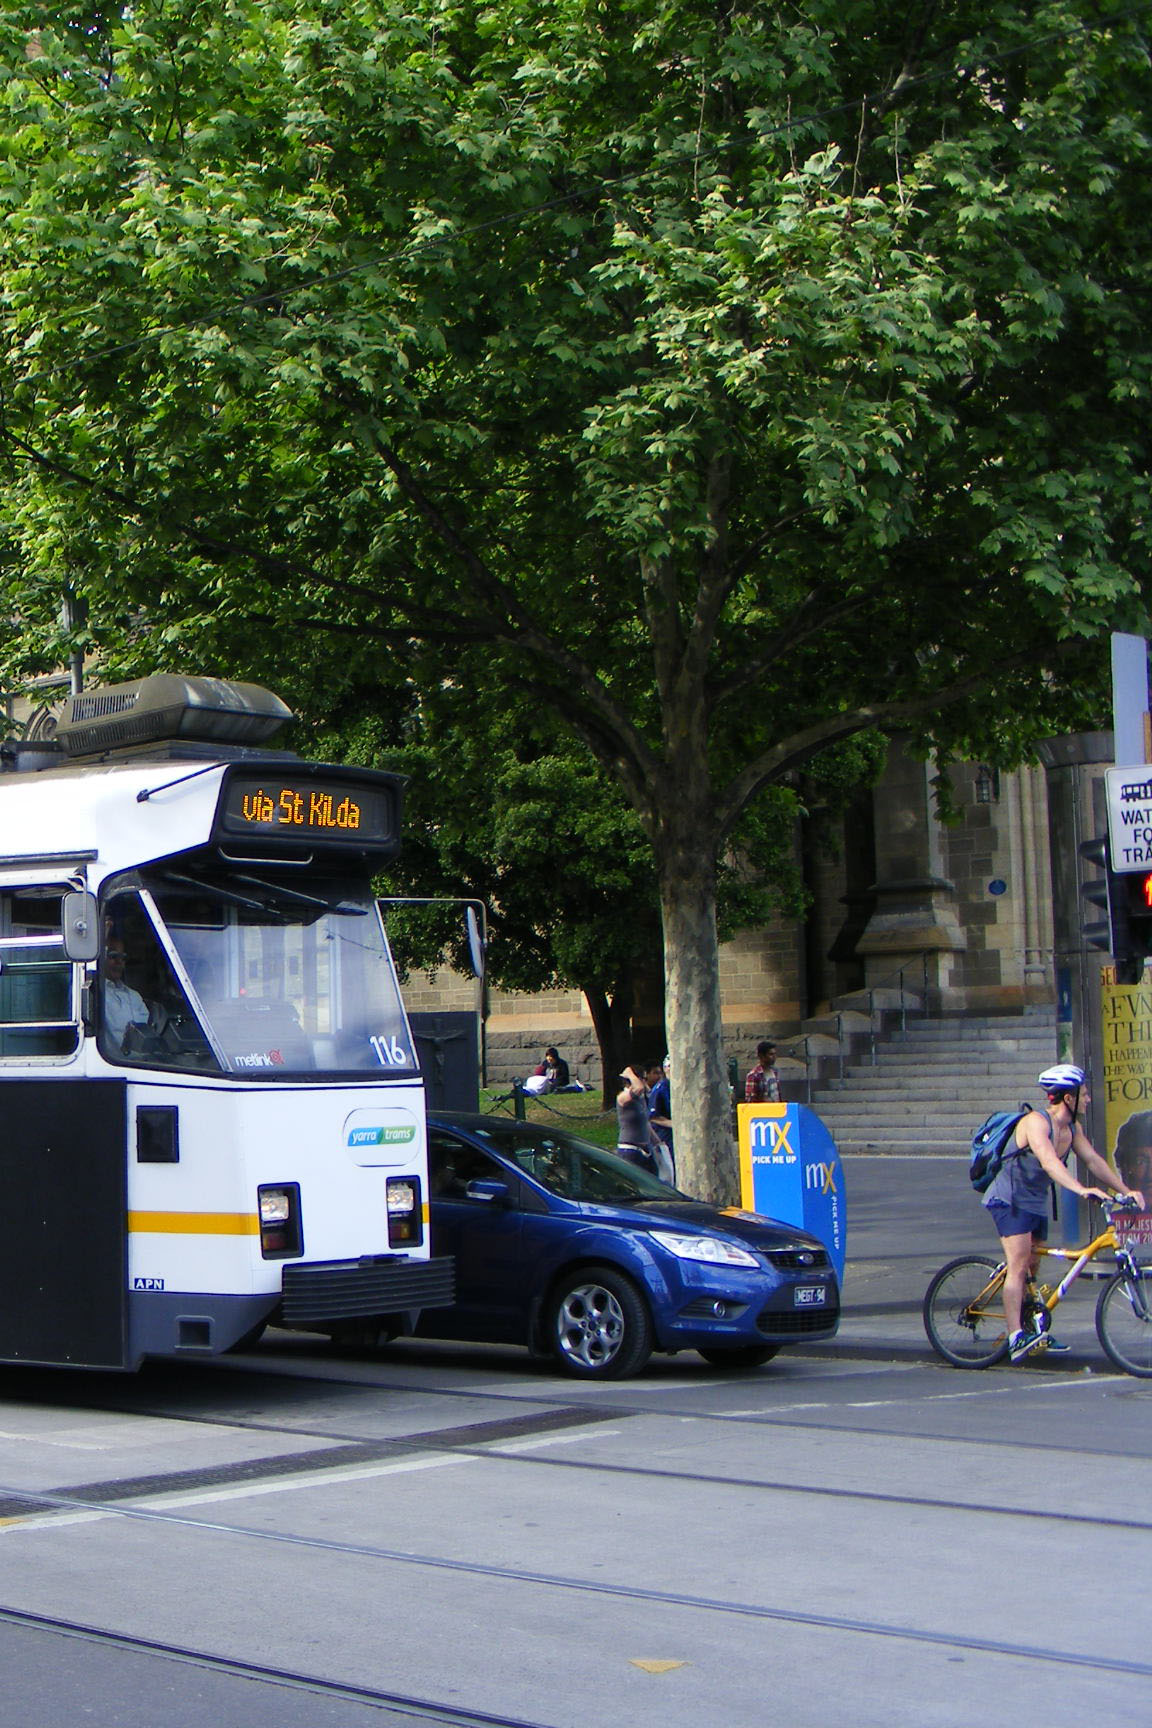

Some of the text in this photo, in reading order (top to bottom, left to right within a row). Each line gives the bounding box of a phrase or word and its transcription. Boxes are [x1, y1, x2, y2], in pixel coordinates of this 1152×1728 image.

[242, 789, 360, 829] via St Kilda
[369, 1035, 407, 1065] 116
[235, 1054, 273, 1067] metlink
[352, 1128, 411, 1144] yarra trams
[752, 1155, 797, 1164] PICK ME UP
[830, 1195, 840, 1250] PICK ME UP
[135, 1279, 163, 1289] APN
